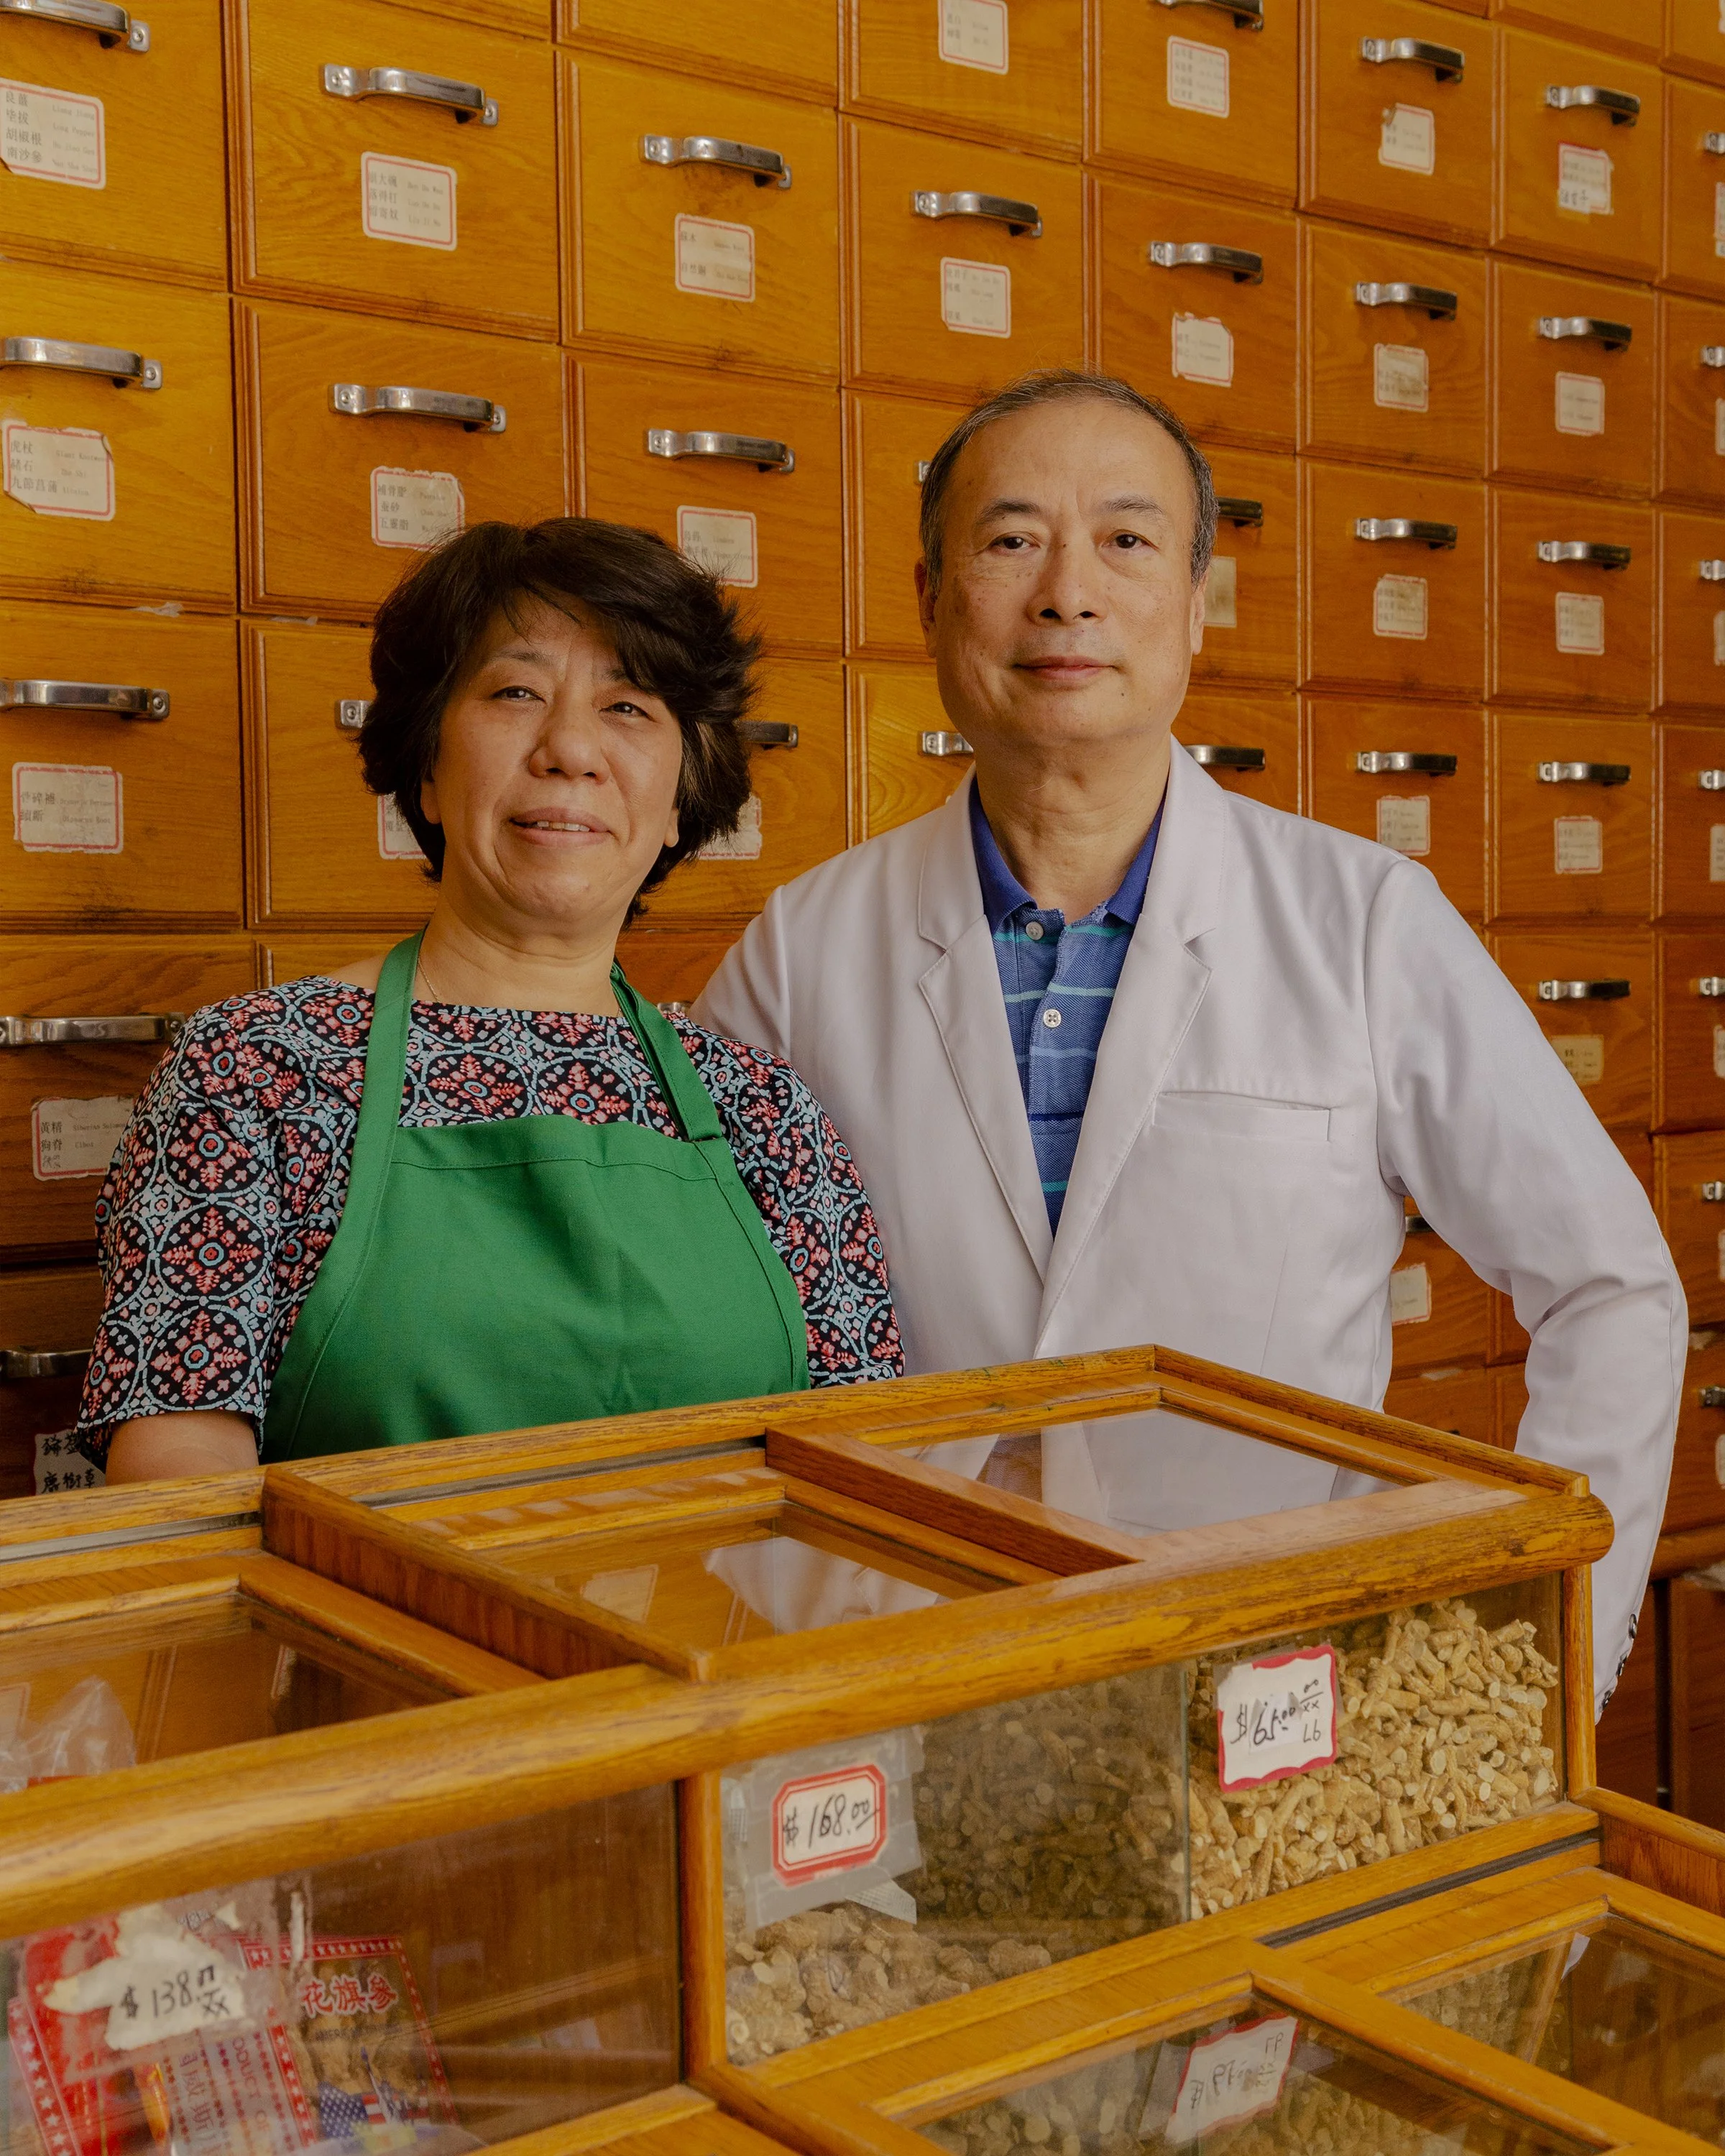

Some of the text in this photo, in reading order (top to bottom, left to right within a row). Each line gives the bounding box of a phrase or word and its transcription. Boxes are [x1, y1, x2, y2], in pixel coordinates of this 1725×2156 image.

[10, 440, 33, 455] 虎杖
[55, 449, 75, 459] Giant
[300, 1973, 399, 2017] 花旗參
[231, 2037, 262, 2101] ODUCT
